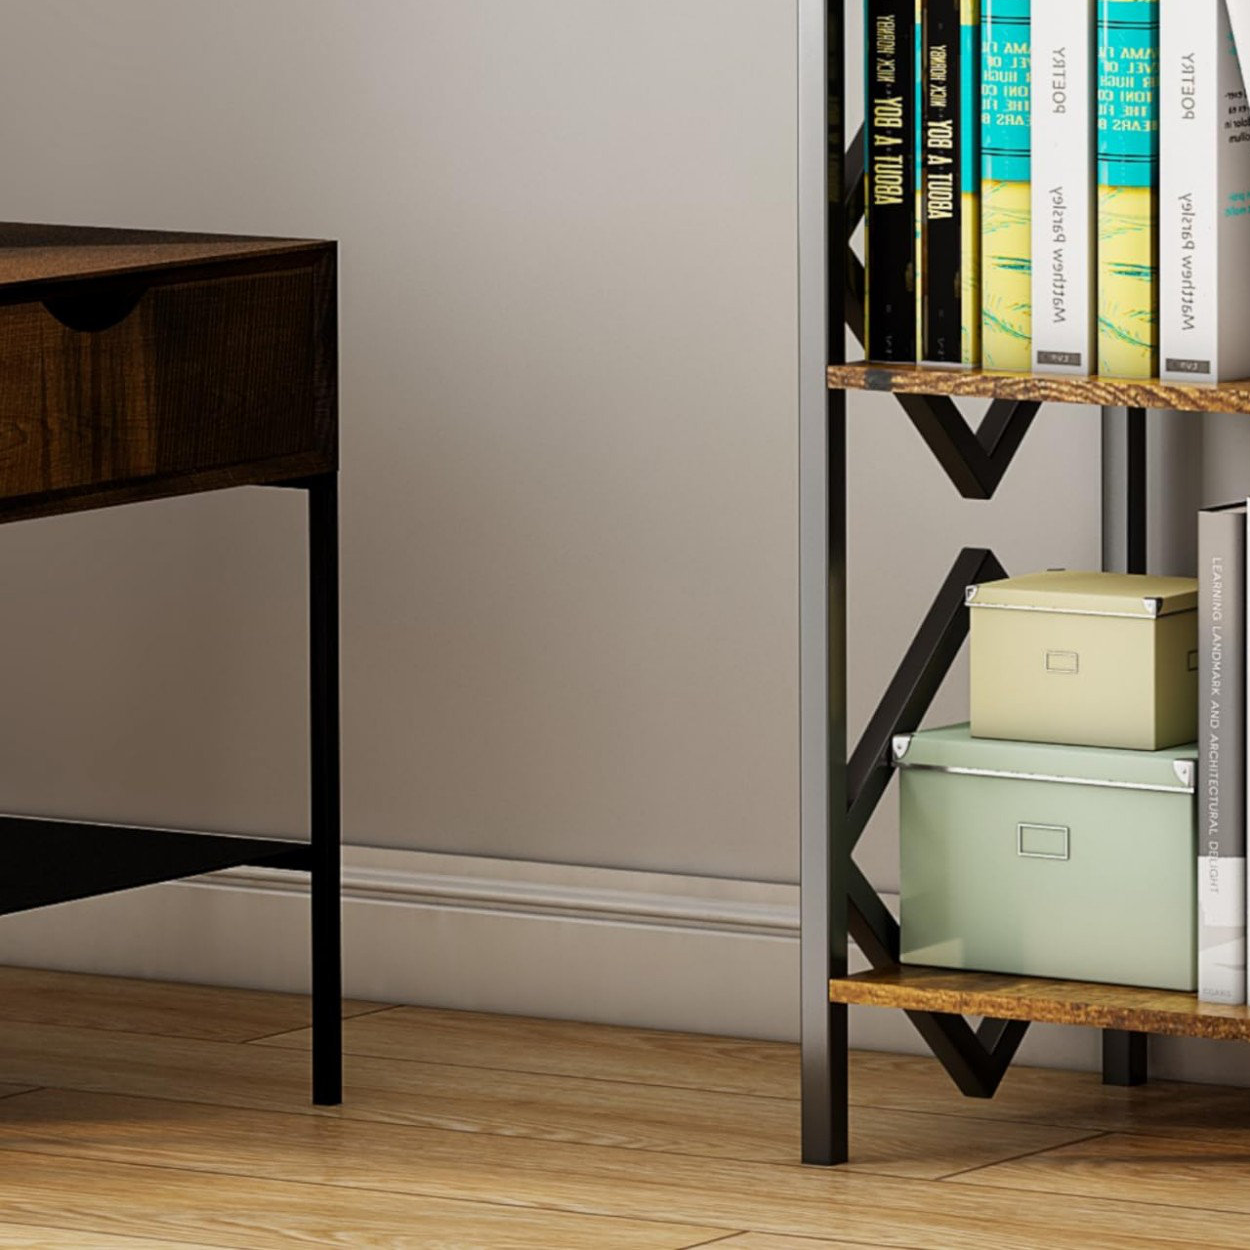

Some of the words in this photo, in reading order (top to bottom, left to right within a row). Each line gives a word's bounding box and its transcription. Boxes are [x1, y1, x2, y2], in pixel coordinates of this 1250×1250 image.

[1212, 557, 1223, 622] LEARNING
[1210, 625, 1222, 696] LANDMARK
[1210, 699, 1220, 729] AND
[1208, 734, 1220, 836] ARCHITECTURAL
[1208, 841, 1220, 895] DELIGHT
